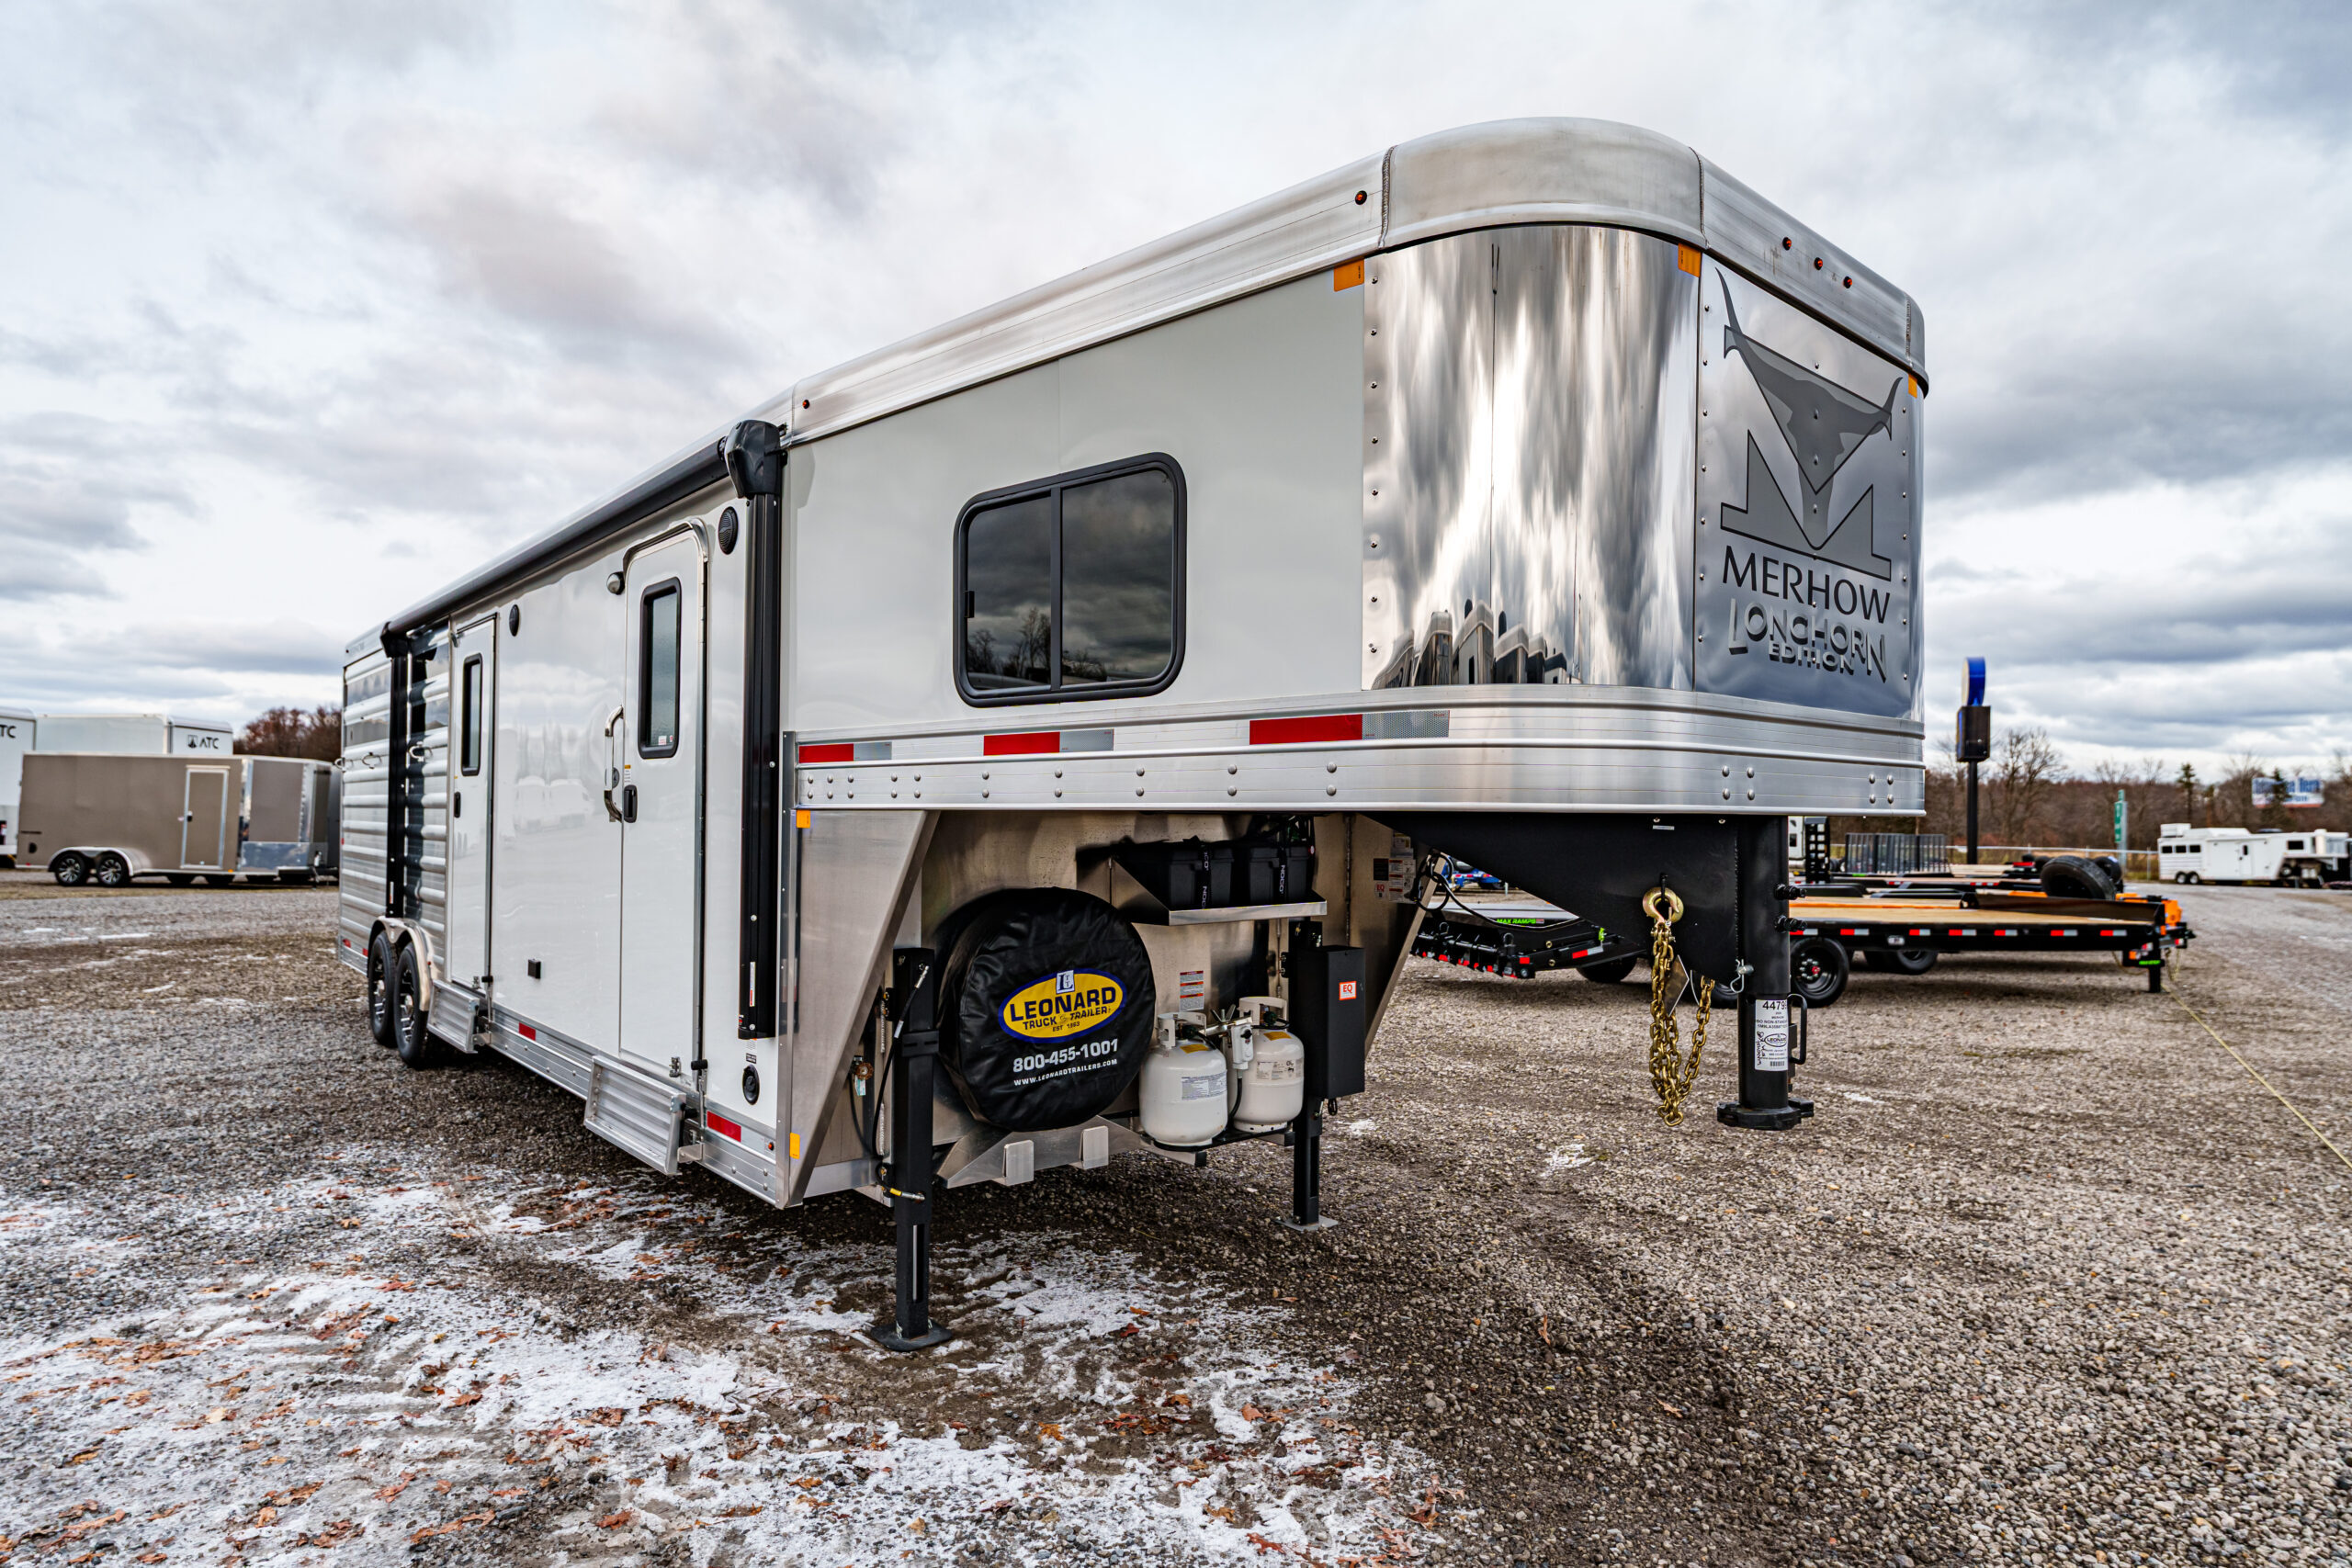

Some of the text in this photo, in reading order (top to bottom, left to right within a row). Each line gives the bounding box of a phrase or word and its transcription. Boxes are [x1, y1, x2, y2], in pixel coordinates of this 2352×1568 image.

[1723, 545, 1891, 624] MERHOW
[1728, 598, 1887, 683] LONGHORN
[1768, 640, 1855, 675] EDITION
[199, 737, 220, 750] ATC
[1010, 987, 1116, 1022] LEONARD
[1342, 984, 1353, 993] EQ
[1023, 1017, 1057, 1031] TRUCK
[1069, 1006, 1108, 1021] TRAILER
[1012, 1038, 1119, 1073] 800-455-1001
[1013, 1058, 1118, 1086] WWW.LEONARDTRAILERS.COM
